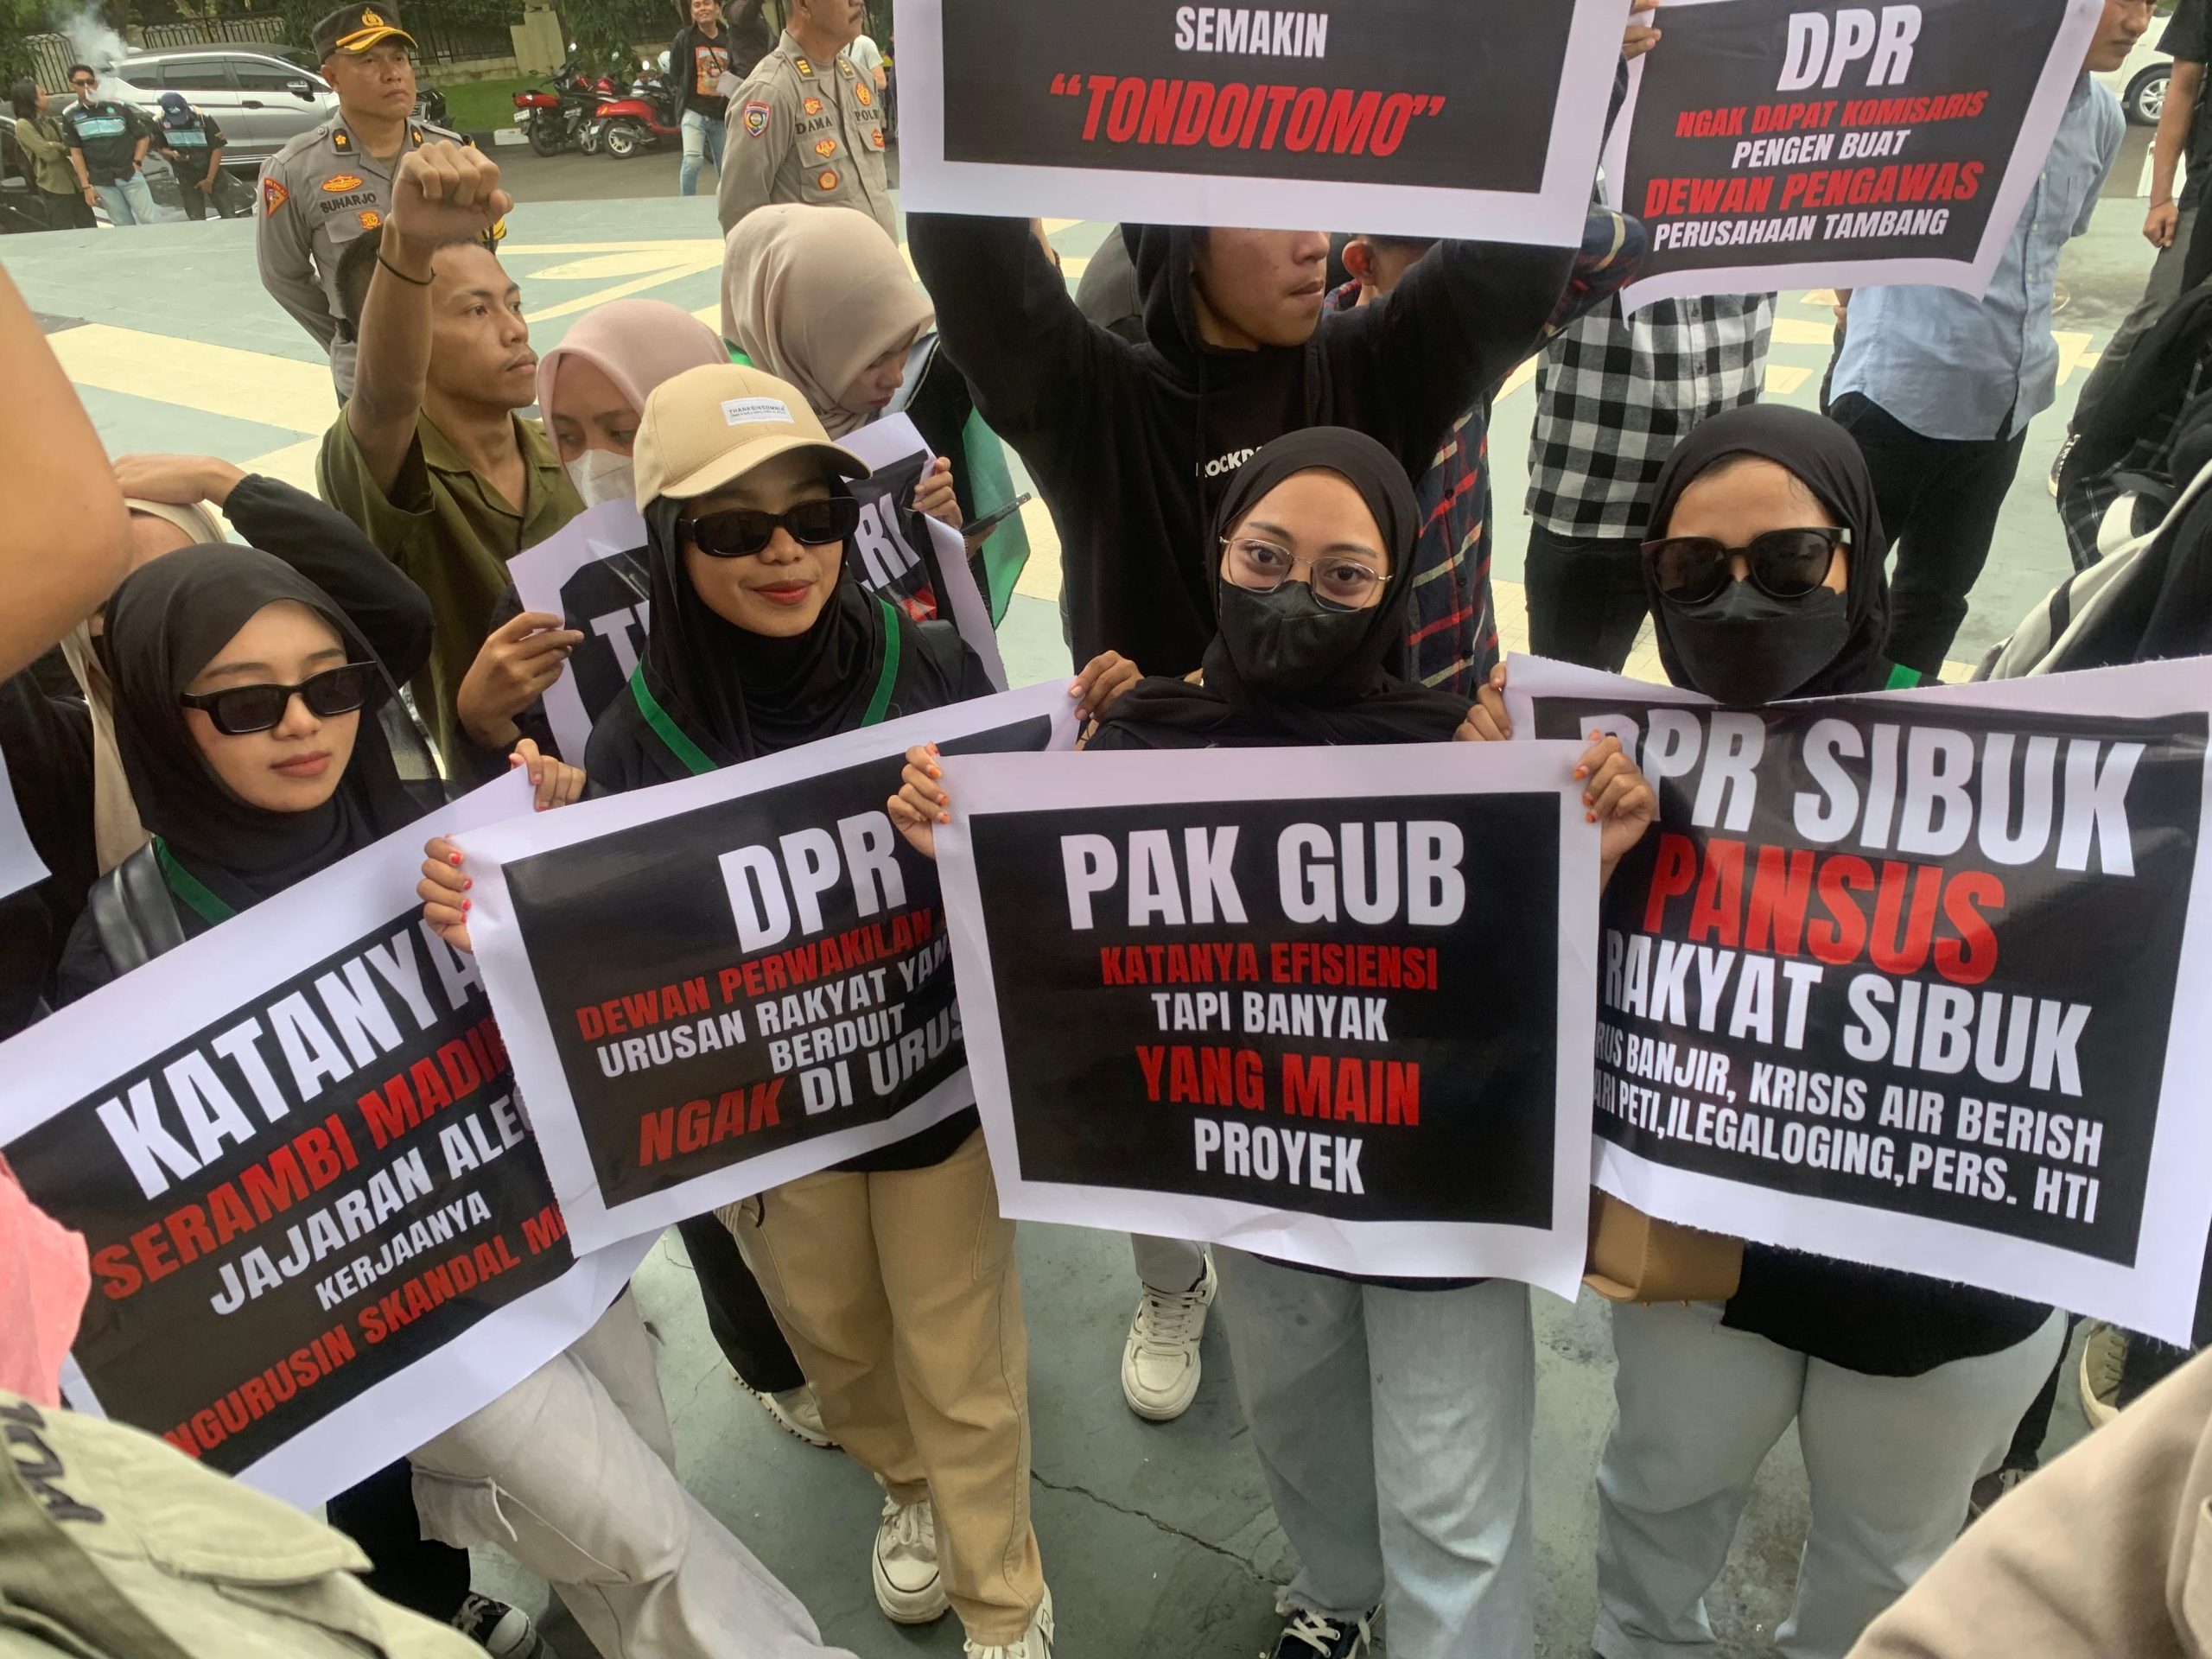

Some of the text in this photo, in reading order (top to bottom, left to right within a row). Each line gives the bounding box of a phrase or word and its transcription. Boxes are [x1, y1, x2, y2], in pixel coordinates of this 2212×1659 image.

[1174, 6, 1328, 59] SEMAKIN
[1776, 5, 1923, 92] DPR
[1675, 91, 1989, 138] NGAK DAPAT KOMISARIS
[1731, 129, 1910, 169] PENGEN BUAT
[320, 192, 377, 214] SUHARJO
[1643, 162, 1985, 219] DEWAN PENGAWAS
[1653, 207, 1950, 252] PERUSAHAAN TAMBANG
[1196, 446, 1262, 478] OCKD
[1793, 717, 2145, 877] SIBUK
[718, 810, 906, 953] DPR
[1061, 821, 1466, 930] PAK GUB
[1643, 833, 2005, 983] PANSUS
[575, 908, 932, 1041] DEWAN PERWAKILAN
[597, 934, 950, 1078] URUSAN RAKYAT YAN
[1101, 942, 1438, 990] KATANYA EFISIENSI
[770, 1003, 905, 1073] BERDUIT
[1152, 991, 1388, 1041] TAPI BANYAK
[1605, 929, 2092, 1096] RAKYAT SIBUK
[639, 1077, 785, 1166] NGAK
[799, 1059, 853, 1116] DI
[1135, 1046, 1420, 1126] YANG MAIN
[1626, 1033, 1738, 1101] BANJIR,
[1749, 1061, 1866, 1121] KRISIS
[1879, 1085, 1942, 1135] AIR
[1958, 1099, 2103, 1166] BERISH
[1194, 1118, 1364, 1194] PROYEK
[2033, 1168, 2101, 1224] HTI
[91, 1114, 359, 1300] SERAMBI
[209, 1155, 434, 1316] JAJARAN
[315, 1191, 492, 1311] KERJAANYA
[357, 1235, 520, 1345] SKANDAL
